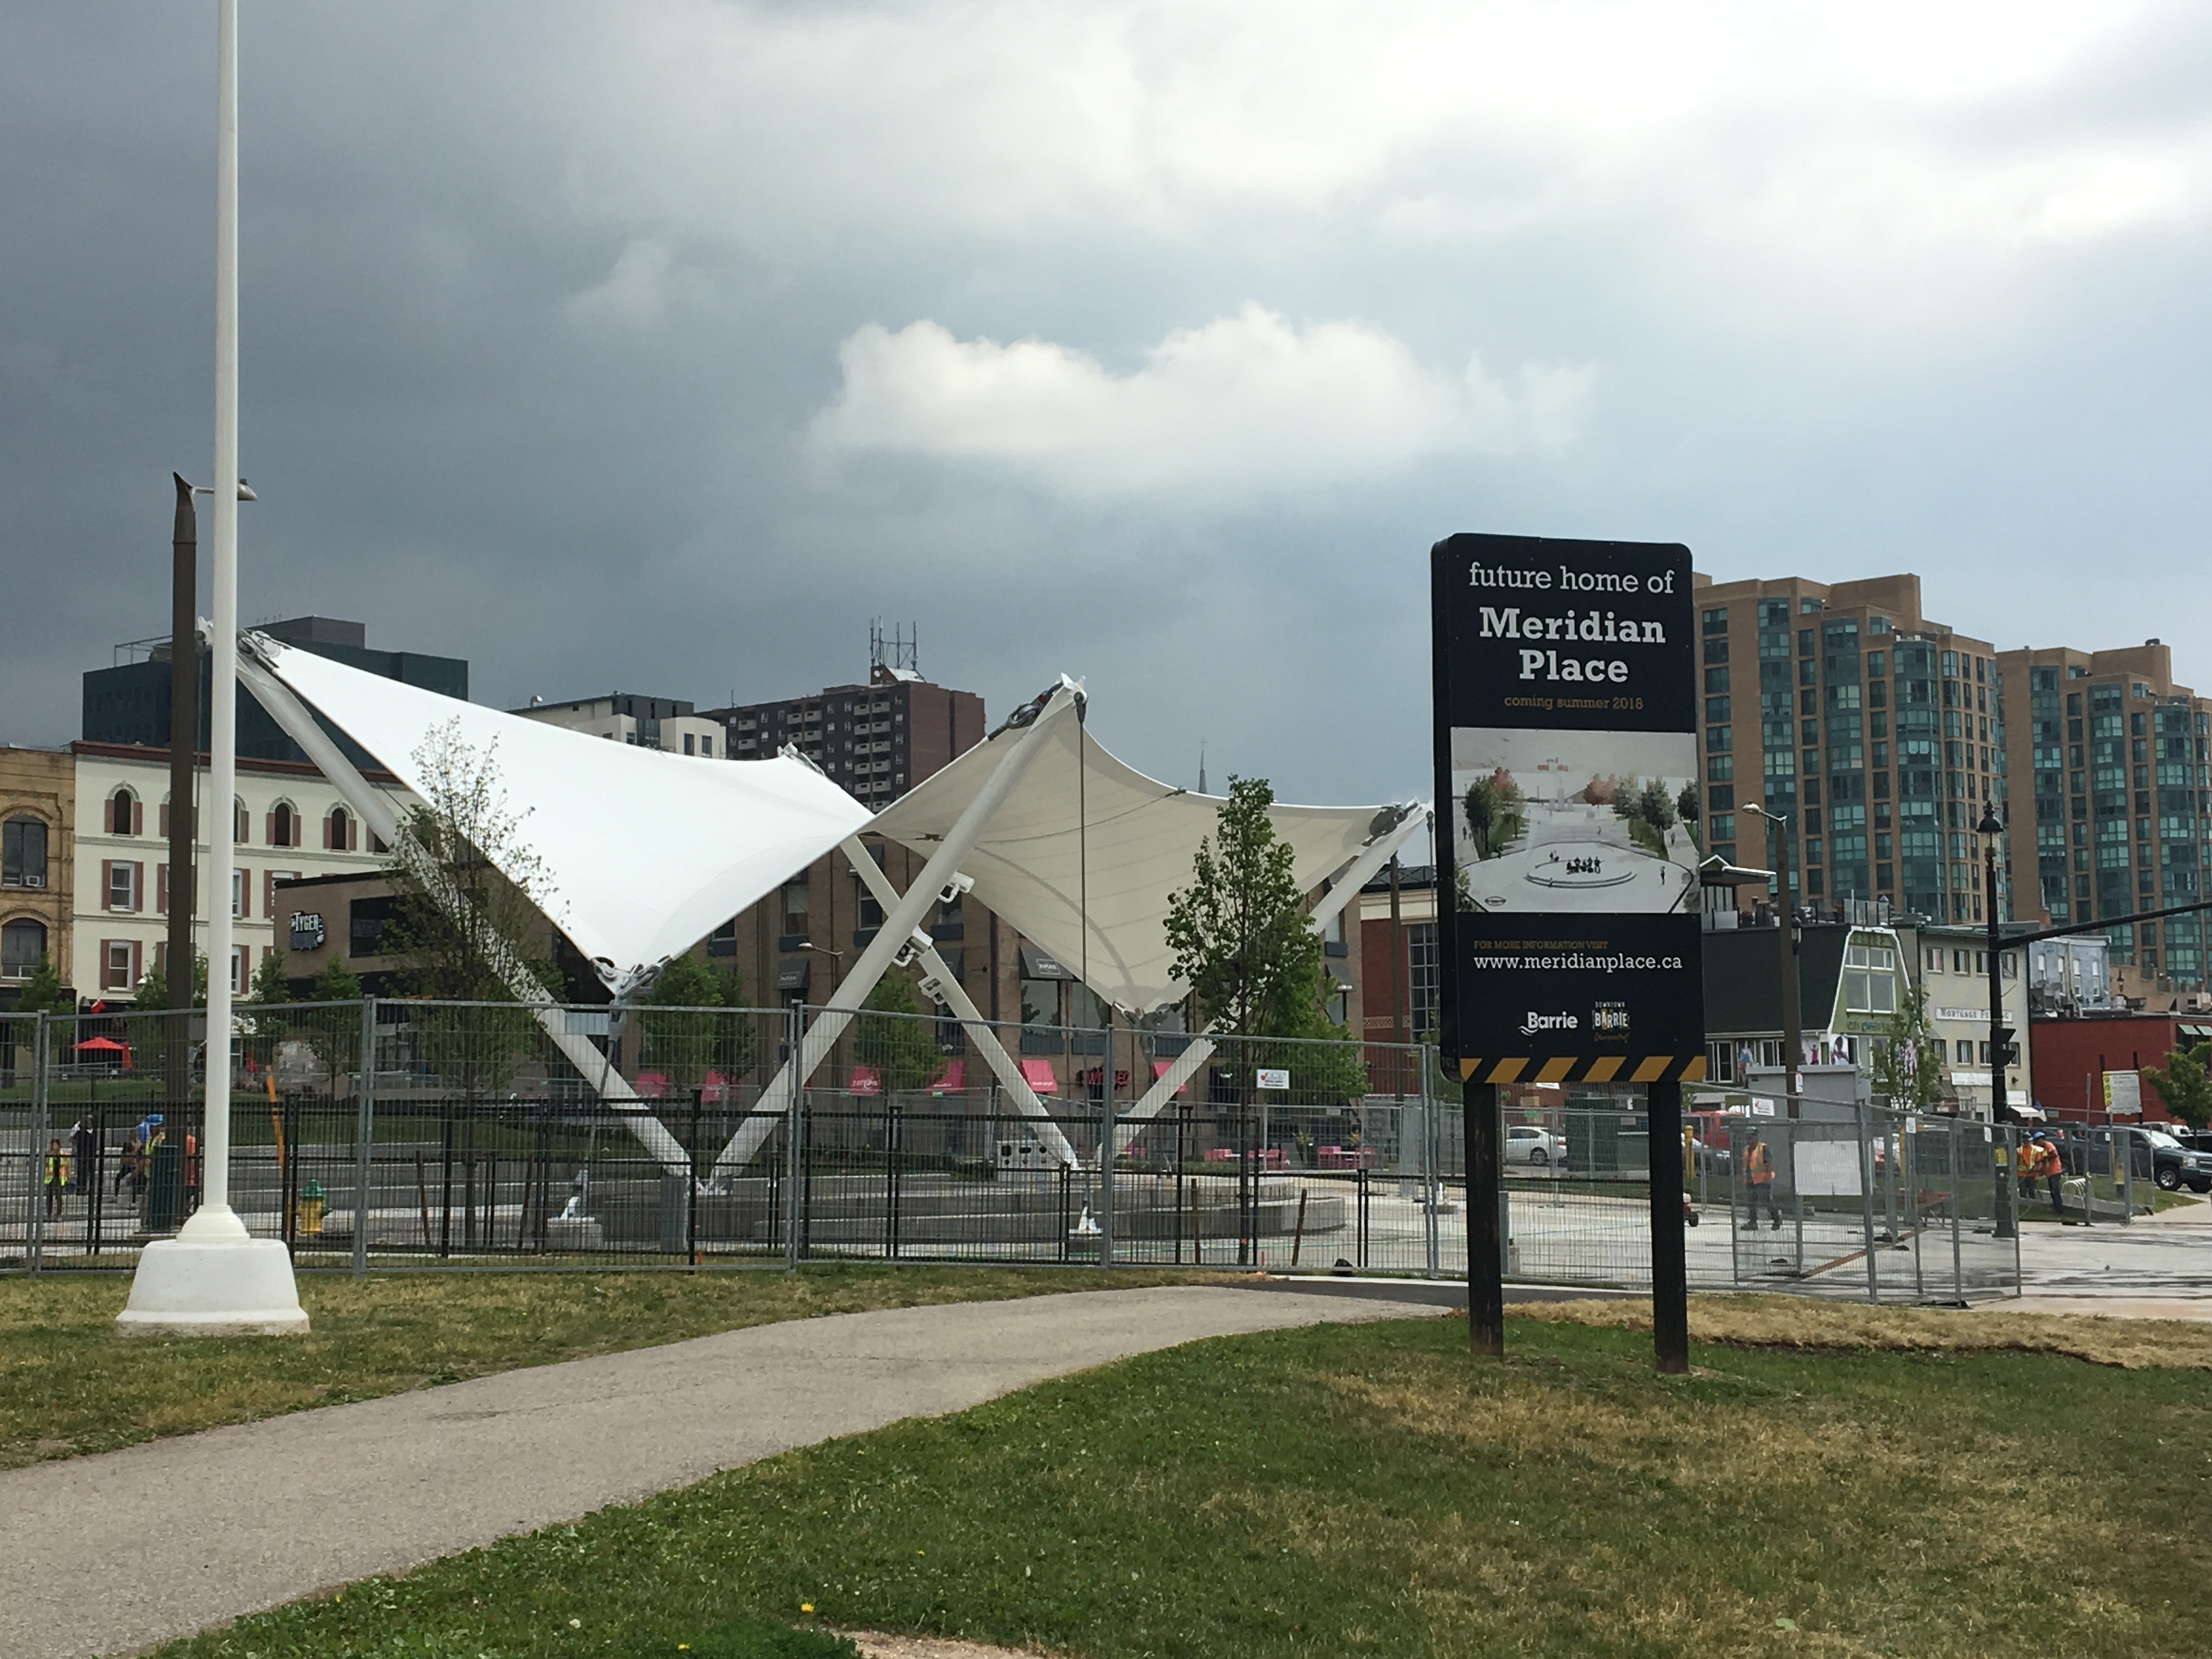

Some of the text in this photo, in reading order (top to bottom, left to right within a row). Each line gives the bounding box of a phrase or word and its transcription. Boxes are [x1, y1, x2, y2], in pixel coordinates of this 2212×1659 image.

[1469, 561, 1675, 594] future home of
[1479, 607, 1666, 644] Meridian
[1519, 649, 1628, 682] Place
[1504, 695, 1644, 710] coming summer 2018
[1474, 940, 1609, 950] FOR MORE INFORMATION VISIT
[1474, 952, 1683, 973] www.meridianplace.ca
[1527, 1011, 1578, 1029] Barrie
[1595, 1011, 1628, 1029] BARRIE
